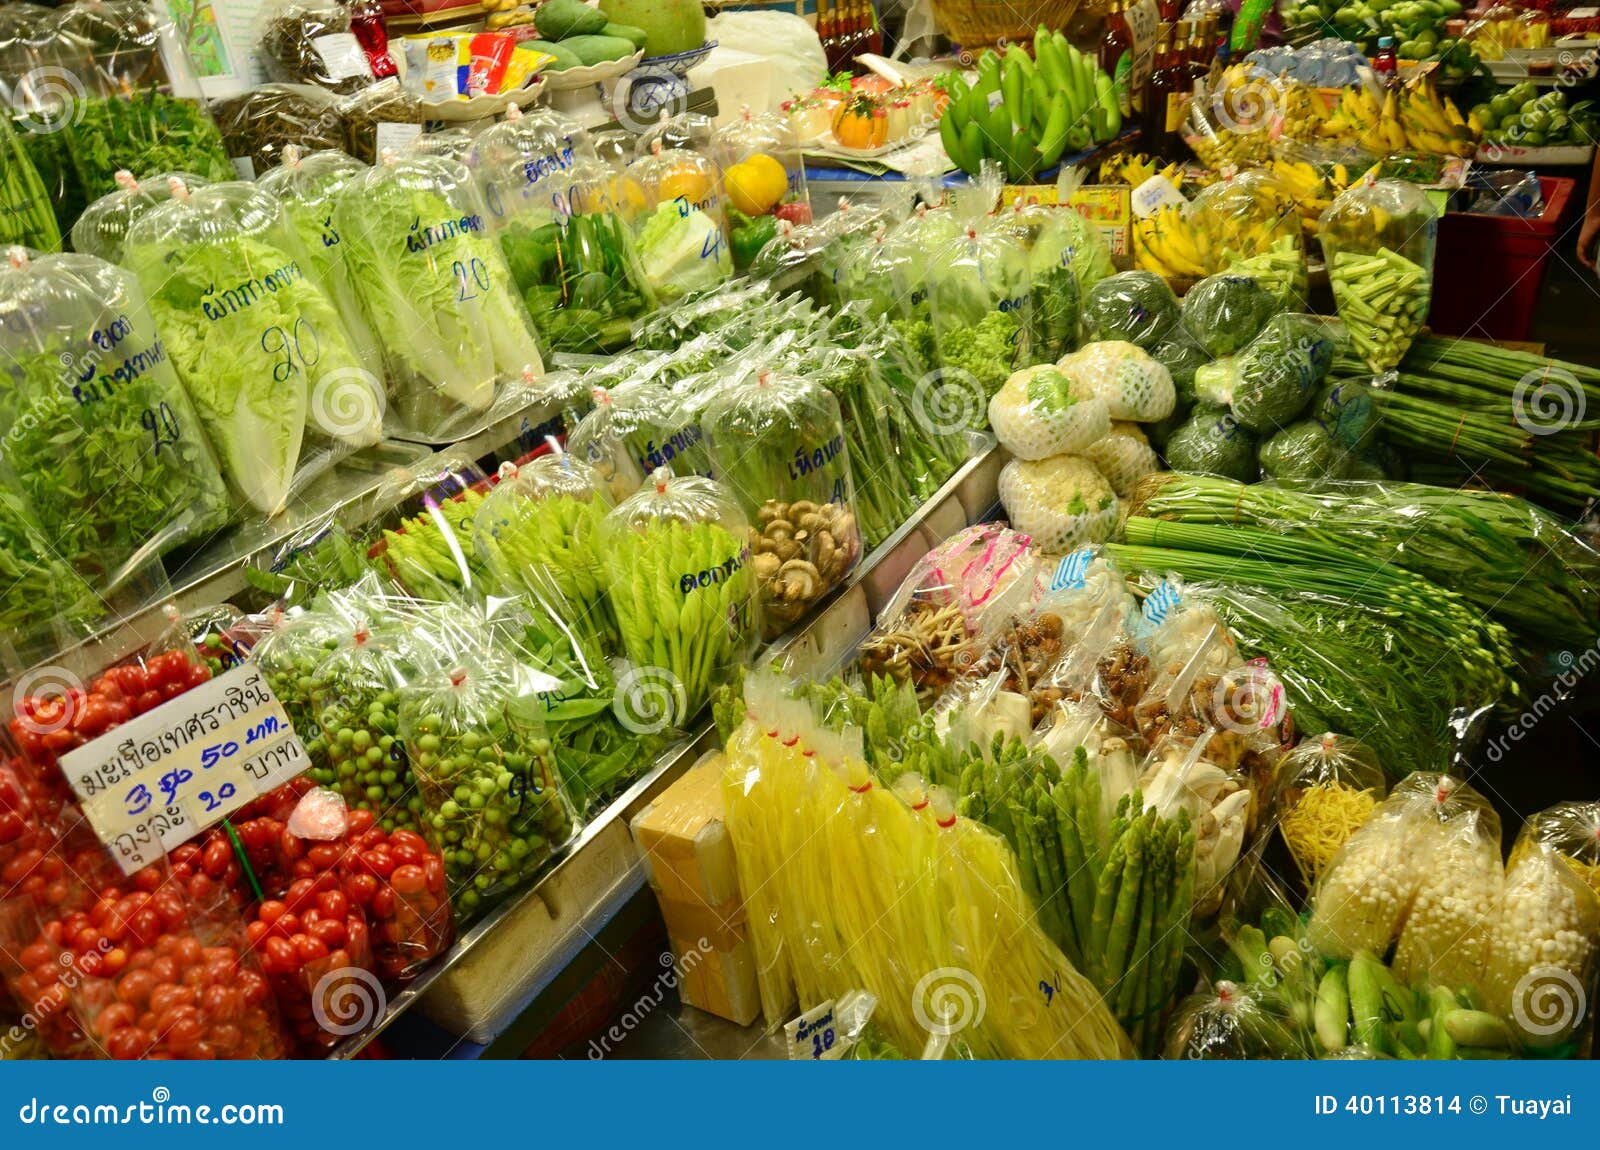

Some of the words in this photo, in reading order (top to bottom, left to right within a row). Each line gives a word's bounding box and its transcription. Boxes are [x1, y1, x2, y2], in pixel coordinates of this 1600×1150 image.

[80, 673, 270, 796] มะเขือเทศราชินี
[198, 782, 237, 812] 20
[243, 739, 299, 780] บาท
